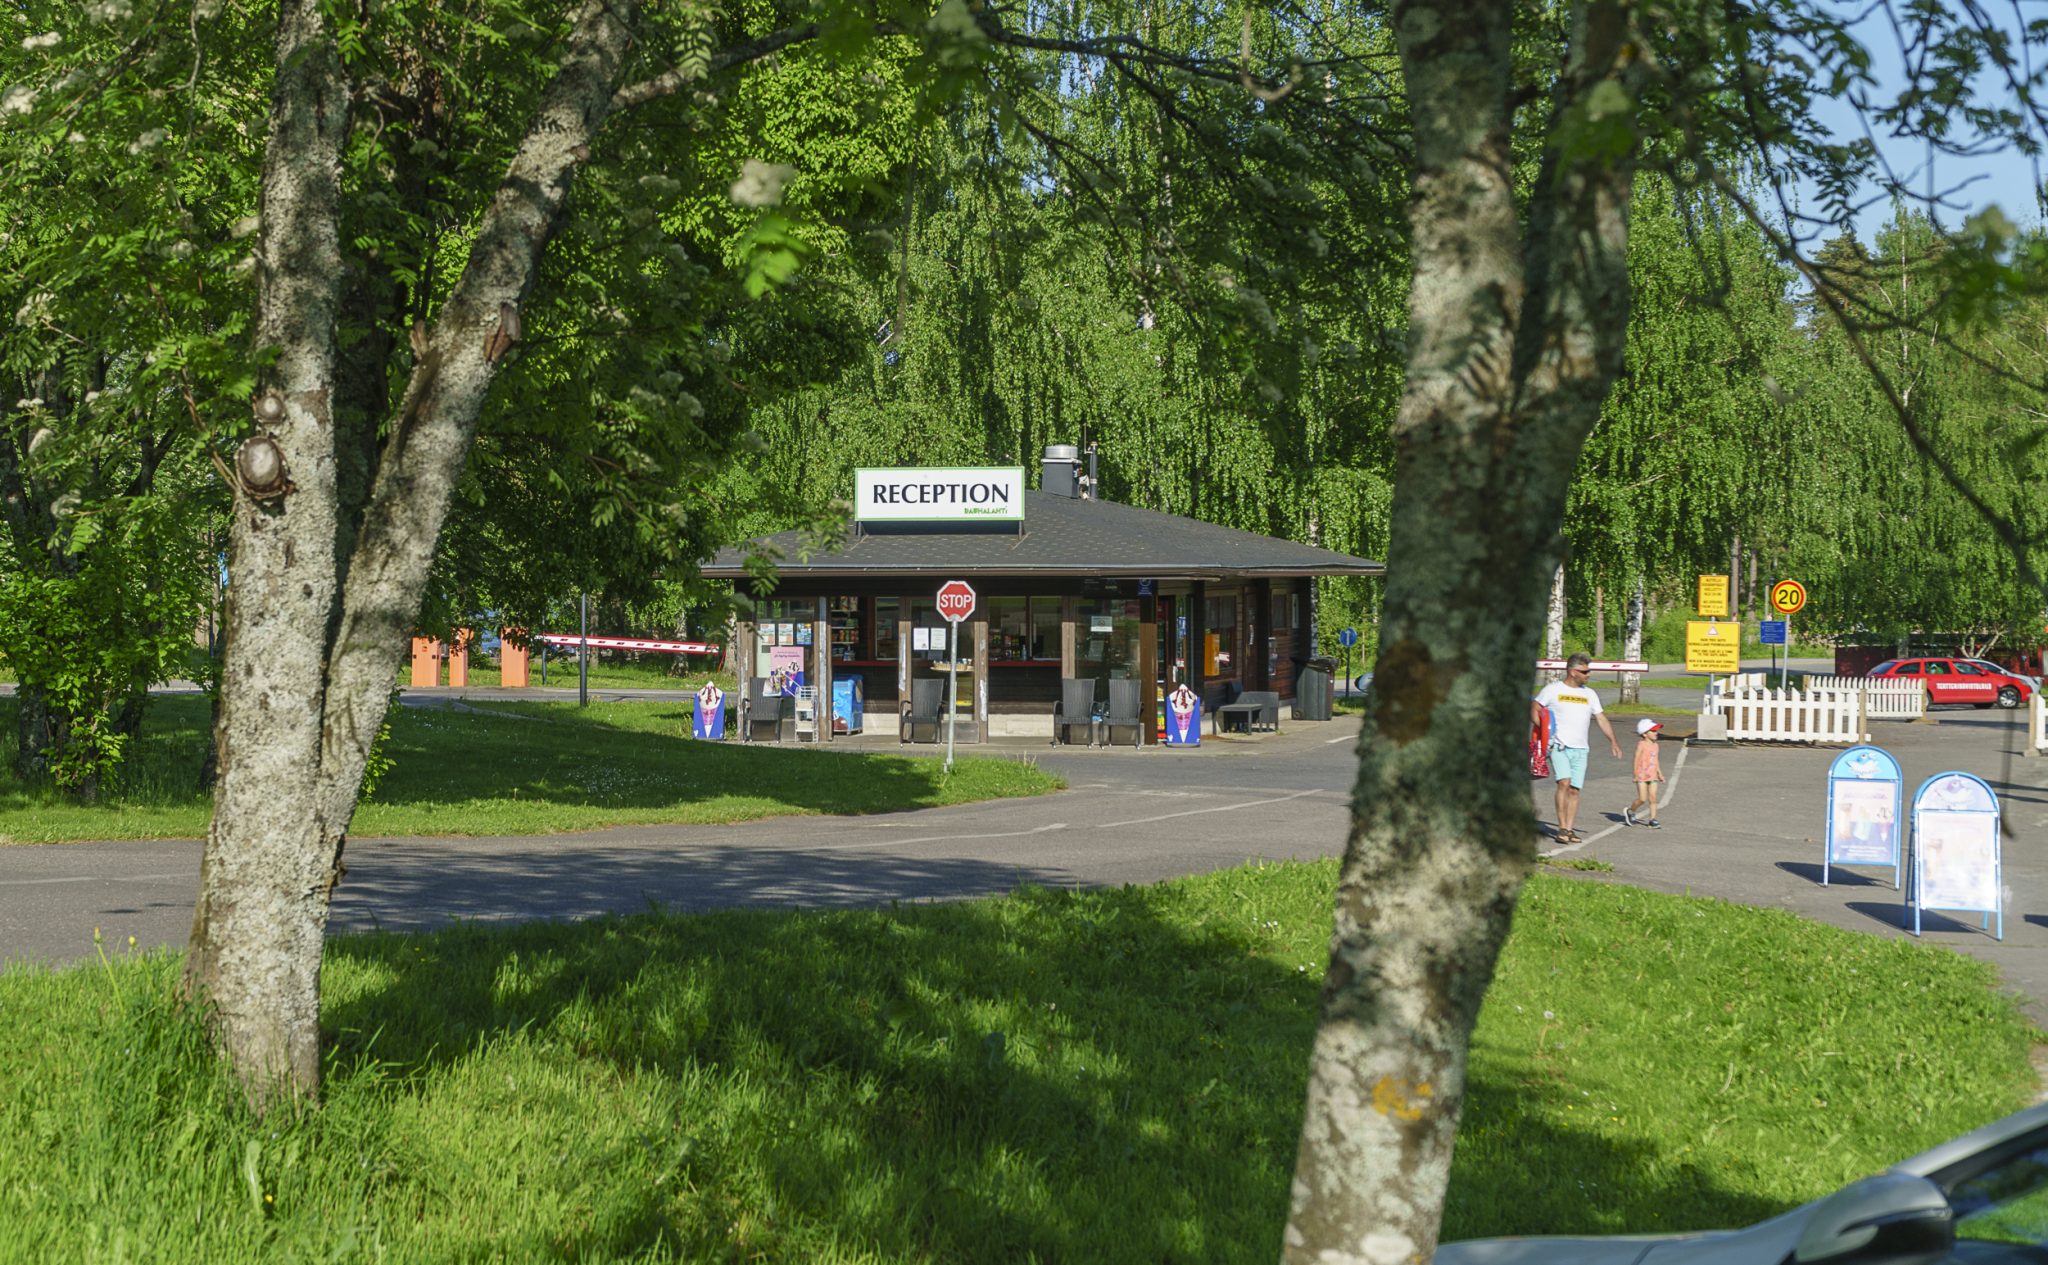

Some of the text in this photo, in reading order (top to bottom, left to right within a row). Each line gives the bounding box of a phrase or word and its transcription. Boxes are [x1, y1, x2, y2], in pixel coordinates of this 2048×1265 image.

[873, 484, 1009, 504] RECEPTION
[940, 594, 972, 608] STOP
[1779, 589, 1799, 605] 20
